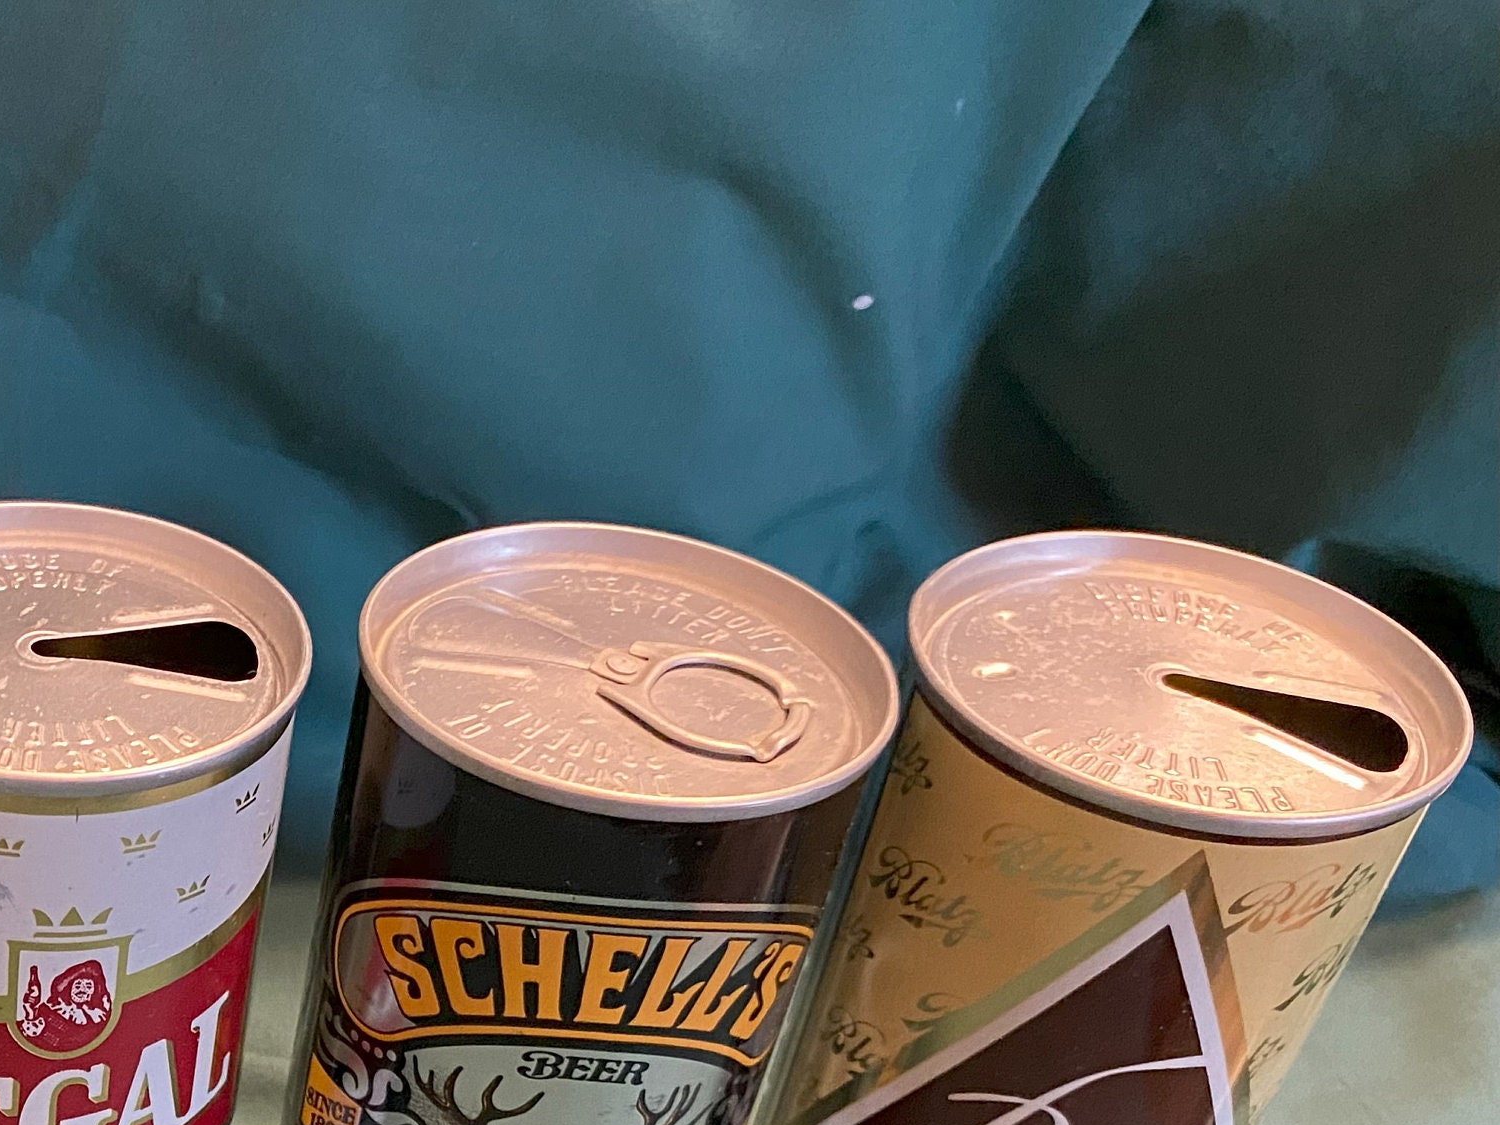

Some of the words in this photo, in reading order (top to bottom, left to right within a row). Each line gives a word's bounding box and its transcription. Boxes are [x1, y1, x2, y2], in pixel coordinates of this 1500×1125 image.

[1021, 728, 1122, 784] DON'T
[1085, 726, 1229, 783] LITTER
[1146, 775, 1296, 814] PLEASE
[516, 1050, 650, 1087] BEER
